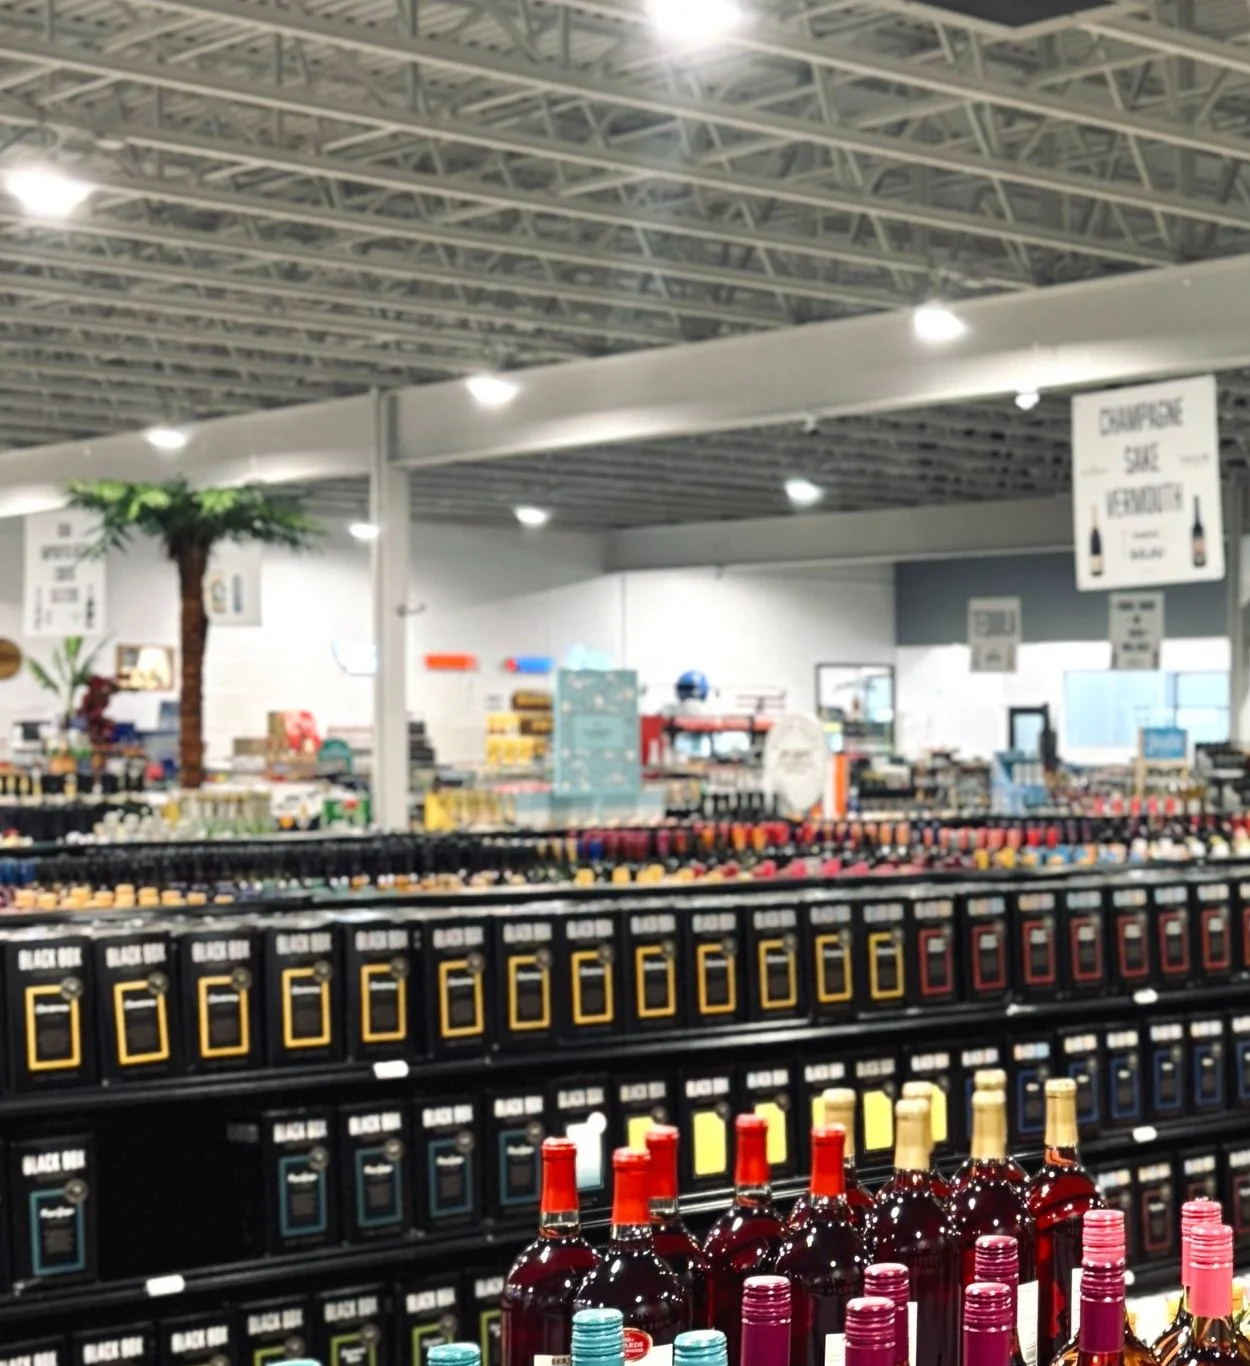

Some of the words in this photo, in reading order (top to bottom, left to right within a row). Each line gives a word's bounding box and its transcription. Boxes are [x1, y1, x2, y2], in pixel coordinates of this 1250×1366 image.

[1100, 396, 1184, 437] CHAMPAGNE
[1124, 442, 1161, 475] SAKE
[1105, 482, 1184, 519] VERMOUTH
[324, 1299, 355, 1323] BLACK
[406, 1290, 434, 1313] BLACK
[248, 1312, 279, 1335] BLACK
[83, 1339, 119, 1365] BLACK
[171, 1330, 204, 1354] BLACK
